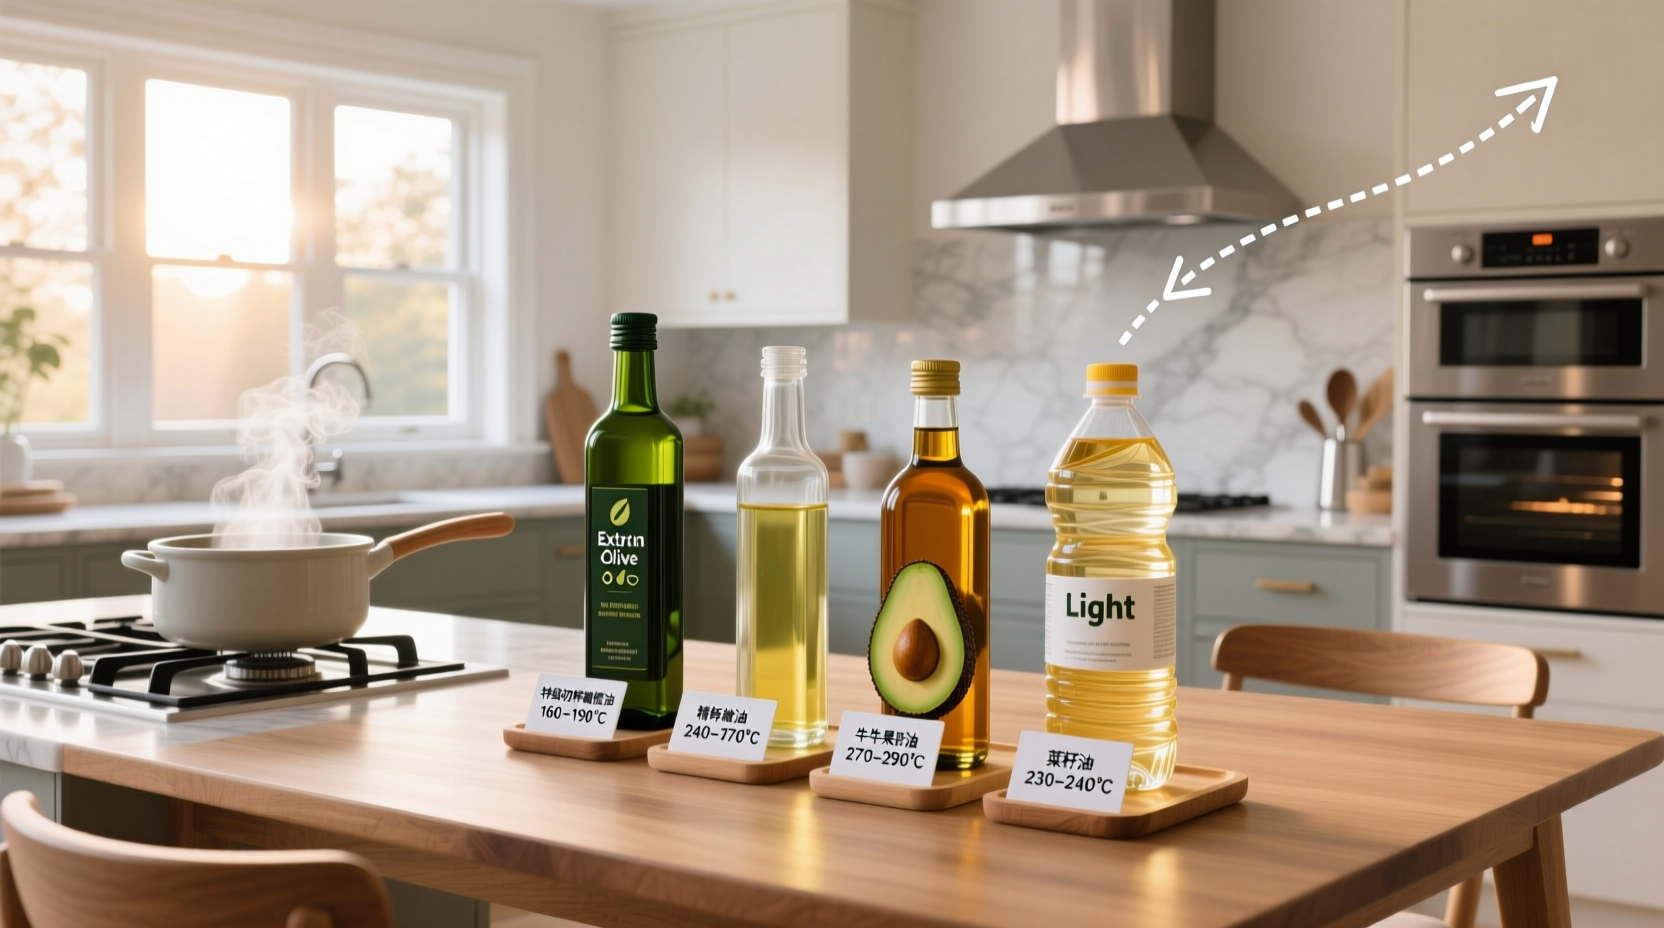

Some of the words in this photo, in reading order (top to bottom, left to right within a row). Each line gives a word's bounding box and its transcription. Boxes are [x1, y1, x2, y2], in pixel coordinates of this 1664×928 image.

[600, 549, 638, 565] Olive
[1066, 592, 1135, 627] Light
[541, 705, 607, 725] 160-190°C
[684, 724, 761, 745] 240-770°C
[1024, 770, 1113, 794] 230-240°C
